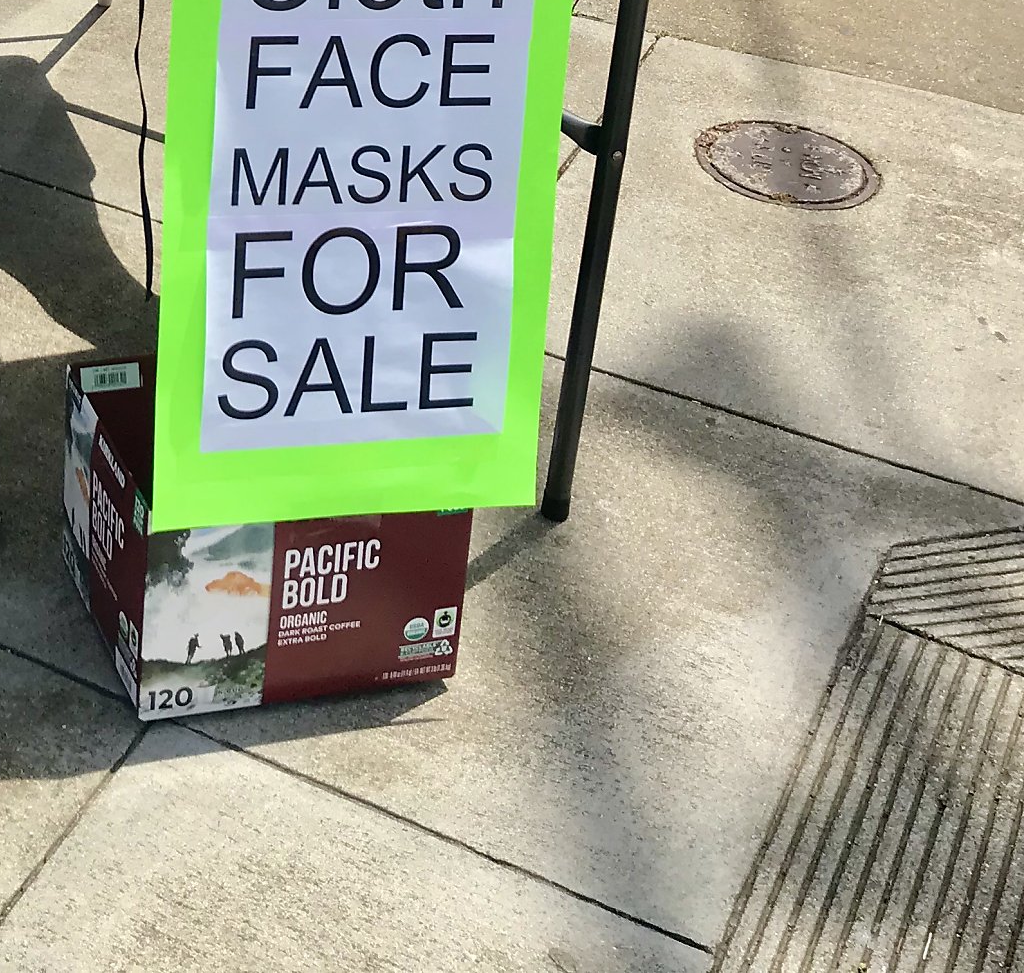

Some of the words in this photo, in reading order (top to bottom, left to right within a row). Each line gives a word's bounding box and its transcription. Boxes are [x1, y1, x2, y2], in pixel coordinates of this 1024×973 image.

[245, 33, 495, 110] FACE
[230, 143, 493, 207] MASKS
[231, 224, 464, 319] FOR
[217, 331, 477, 420] SALE
[91, 499, 113, 561] BOLD
[92, 470, 125, 550] PACIFIC
[284, 538, 381, 580] PACIFIC
[282, 573, 348, 609] BOLD
[277, 636, 304, 647] EXTRA
[304, 633, 327, 643] BOLD
[278, 628, 301, 638] DARK
[302, 624, 328, 635] ROAST
[329, 620, 361, 631] COFFEE
[279, 610, 328, 629] ORGANIC
[148, 686, 193, 711] 120
